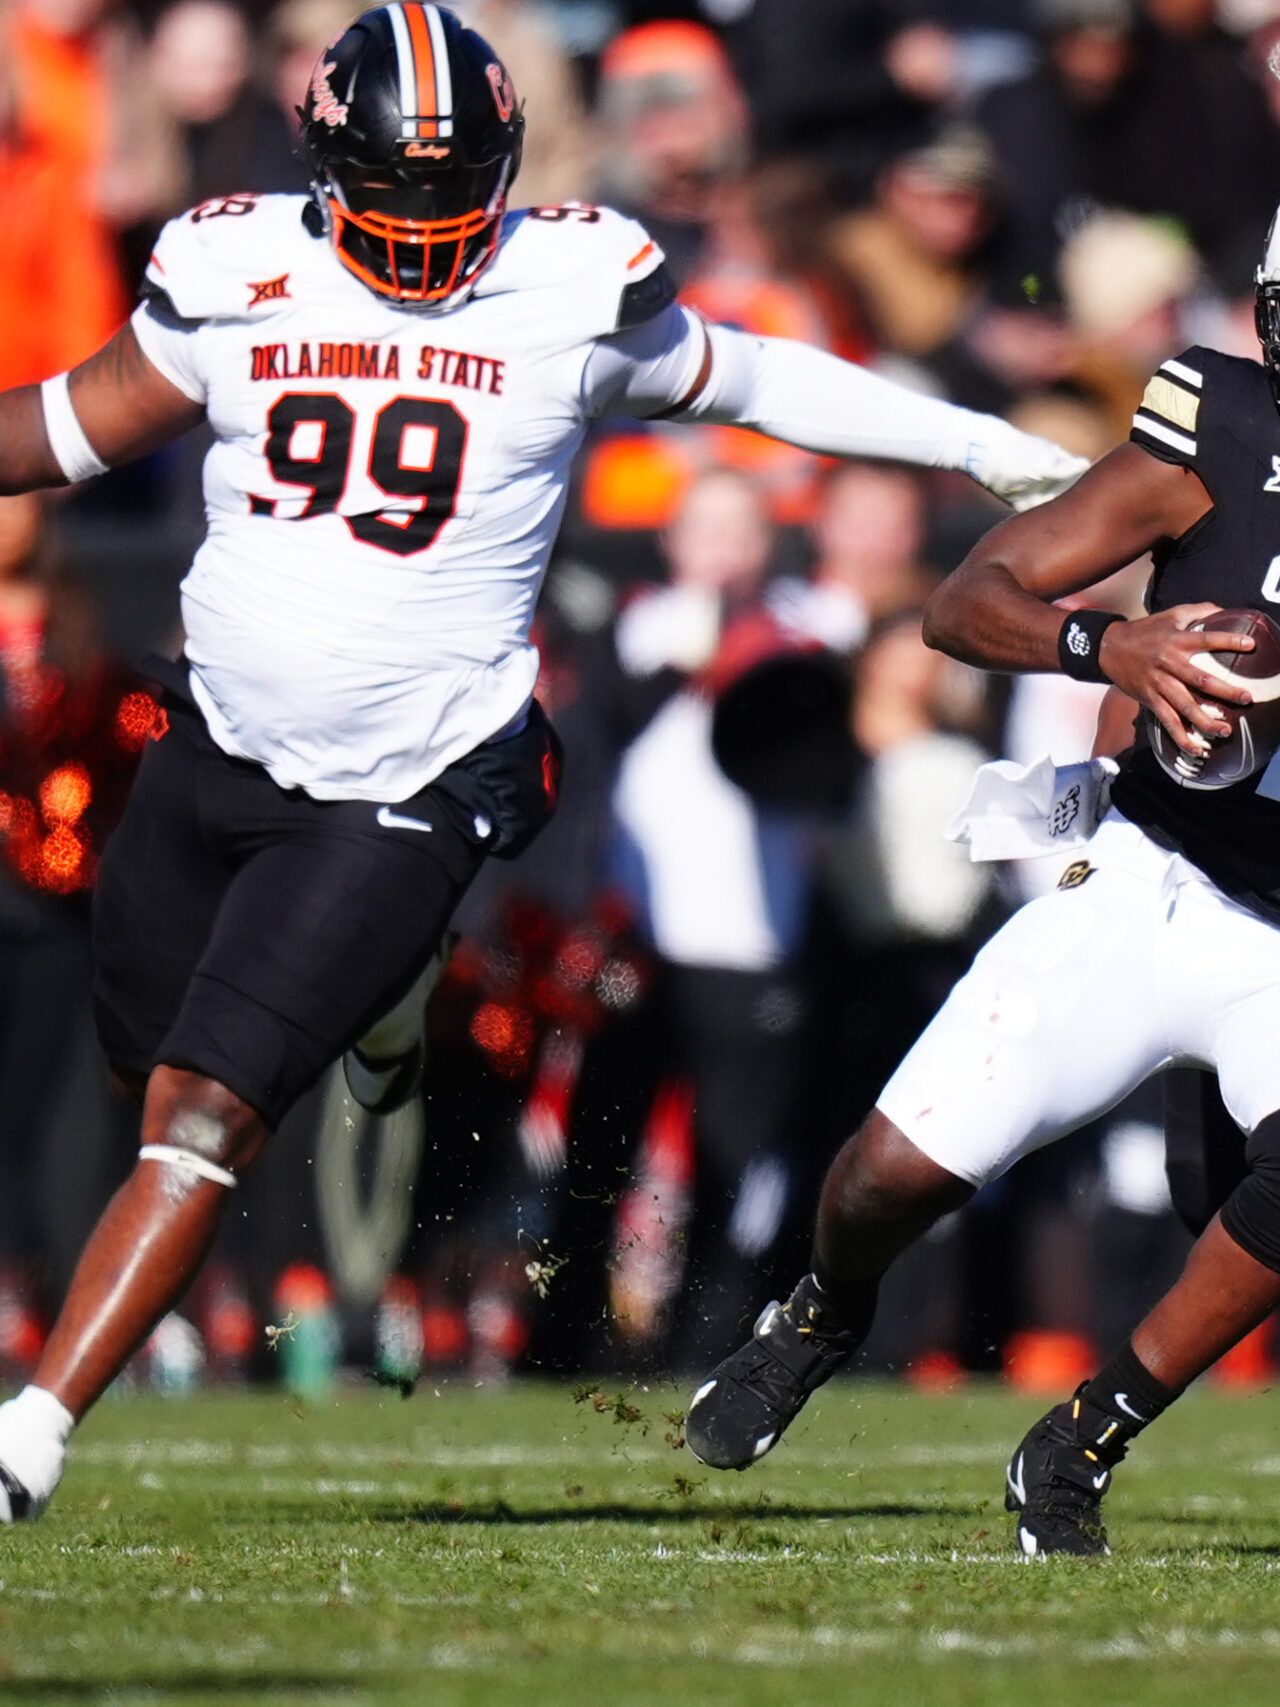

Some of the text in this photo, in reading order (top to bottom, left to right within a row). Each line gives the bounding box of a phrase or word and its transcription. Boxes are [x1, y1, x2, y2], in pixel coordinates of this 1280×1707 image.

[250, 343, 505, 395] OKLAHOMA STATE
[247, 391, 470, 558] 99
